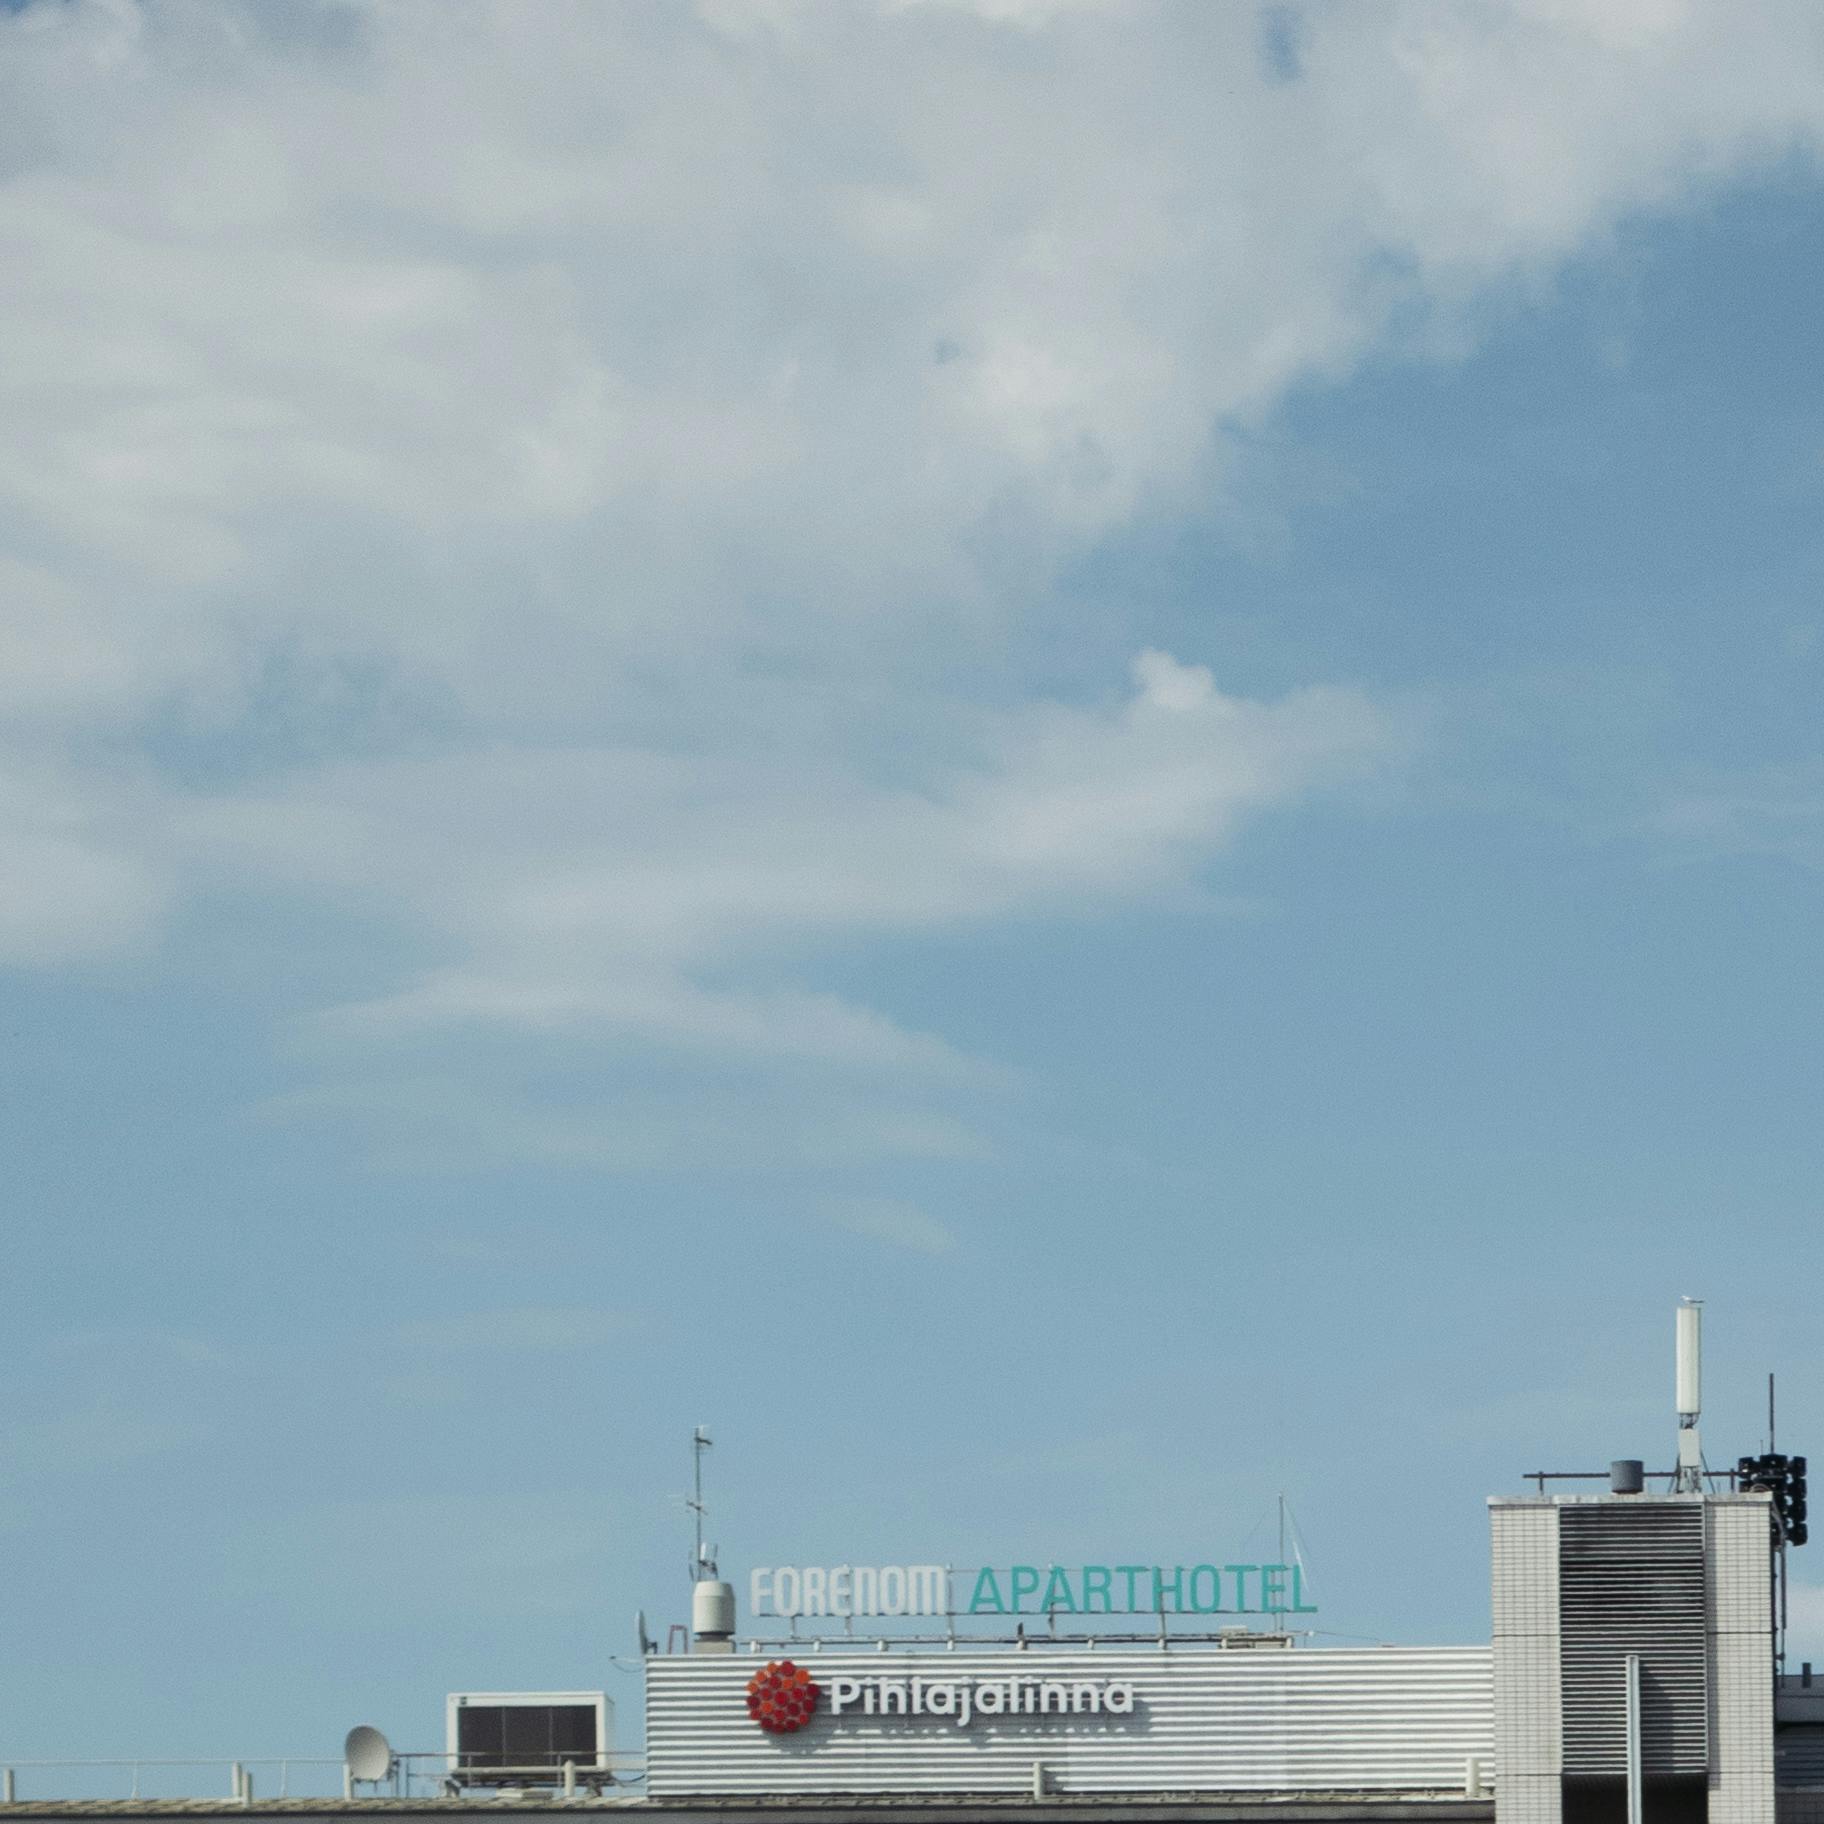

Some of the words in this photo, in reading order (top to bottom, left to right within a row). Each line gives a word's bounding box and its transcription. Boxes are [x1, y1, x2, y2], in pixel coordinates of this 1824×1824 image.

[751, 1566, 947, 1616] FORENOM
[968, 1564, 1318, 1615] APARTHOTEL
[829, 1675, 1136, 1727] Pihlajalinna
